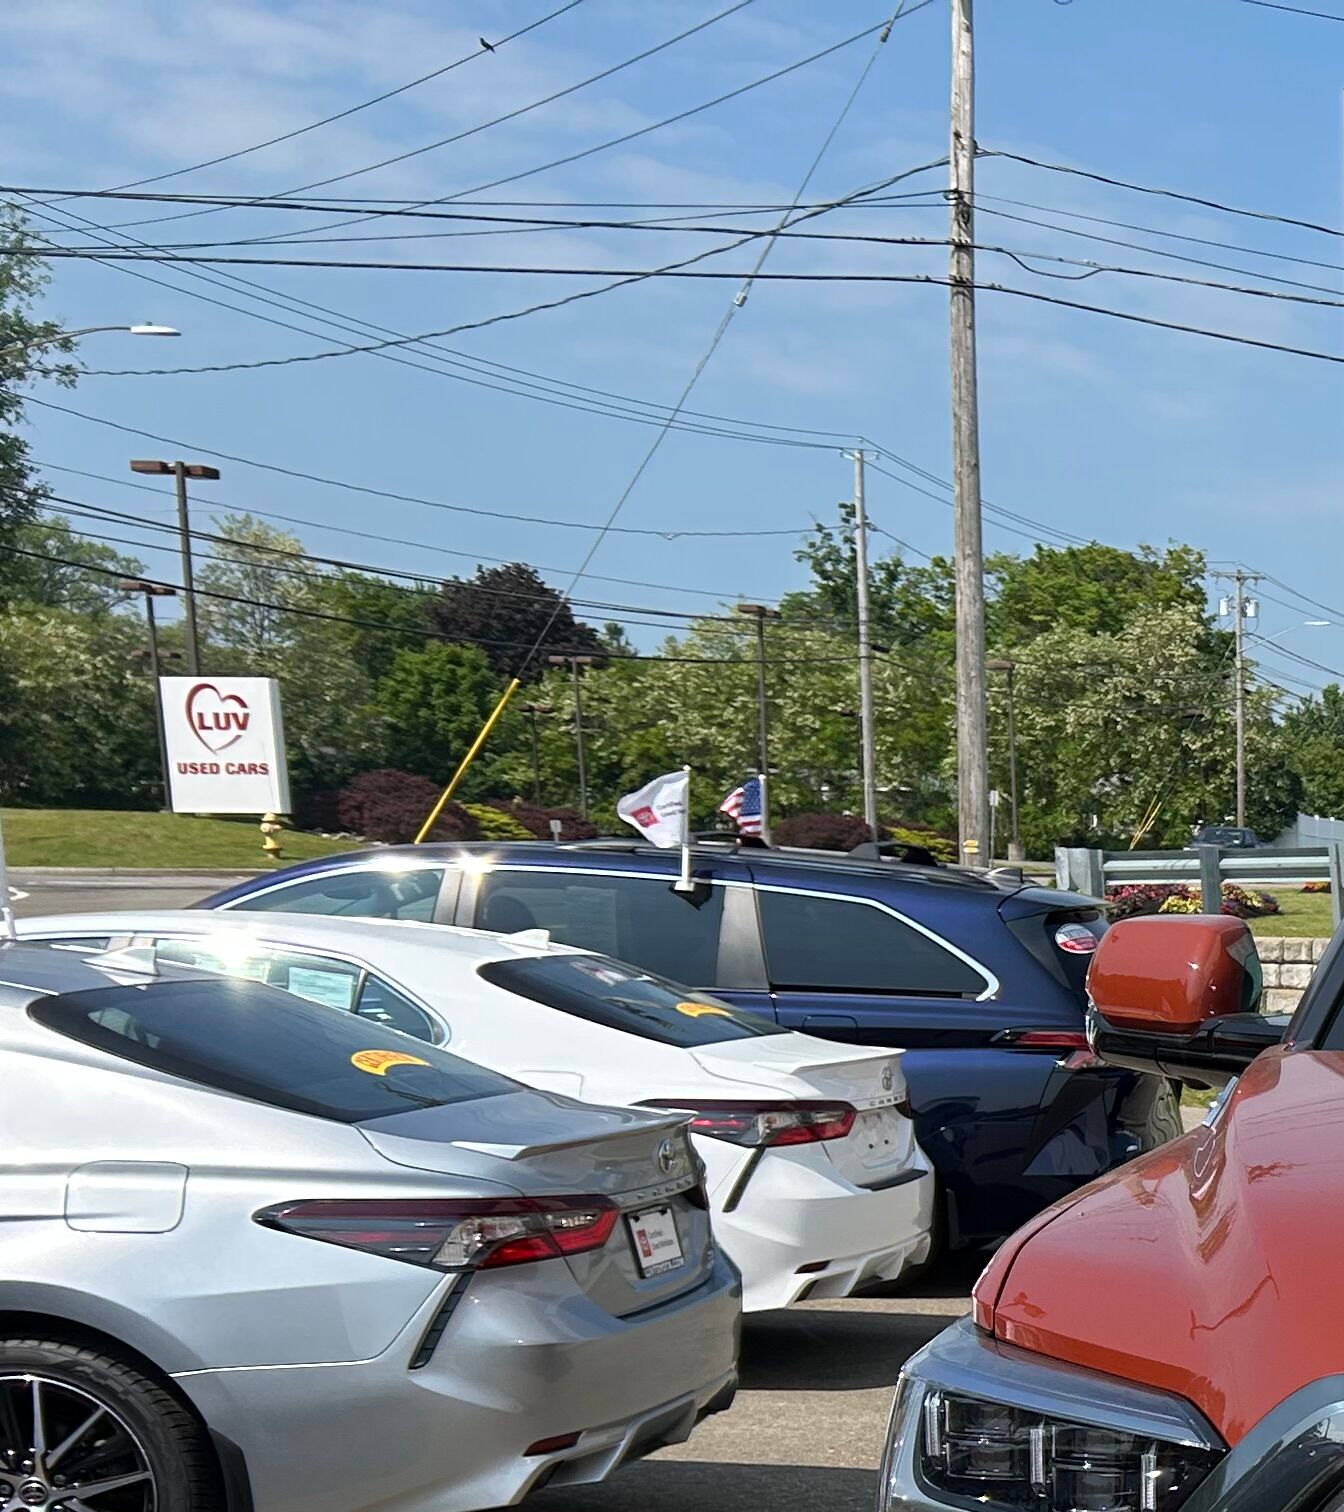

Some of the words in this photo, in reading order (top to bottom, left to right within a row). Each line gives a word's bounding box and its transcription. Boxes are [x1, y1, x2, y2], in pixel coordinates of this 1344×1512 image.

[197, 711, 250, 731] LUV
[177, 762, 220, 775] USED
[224, 762, 269, 776] CARS
